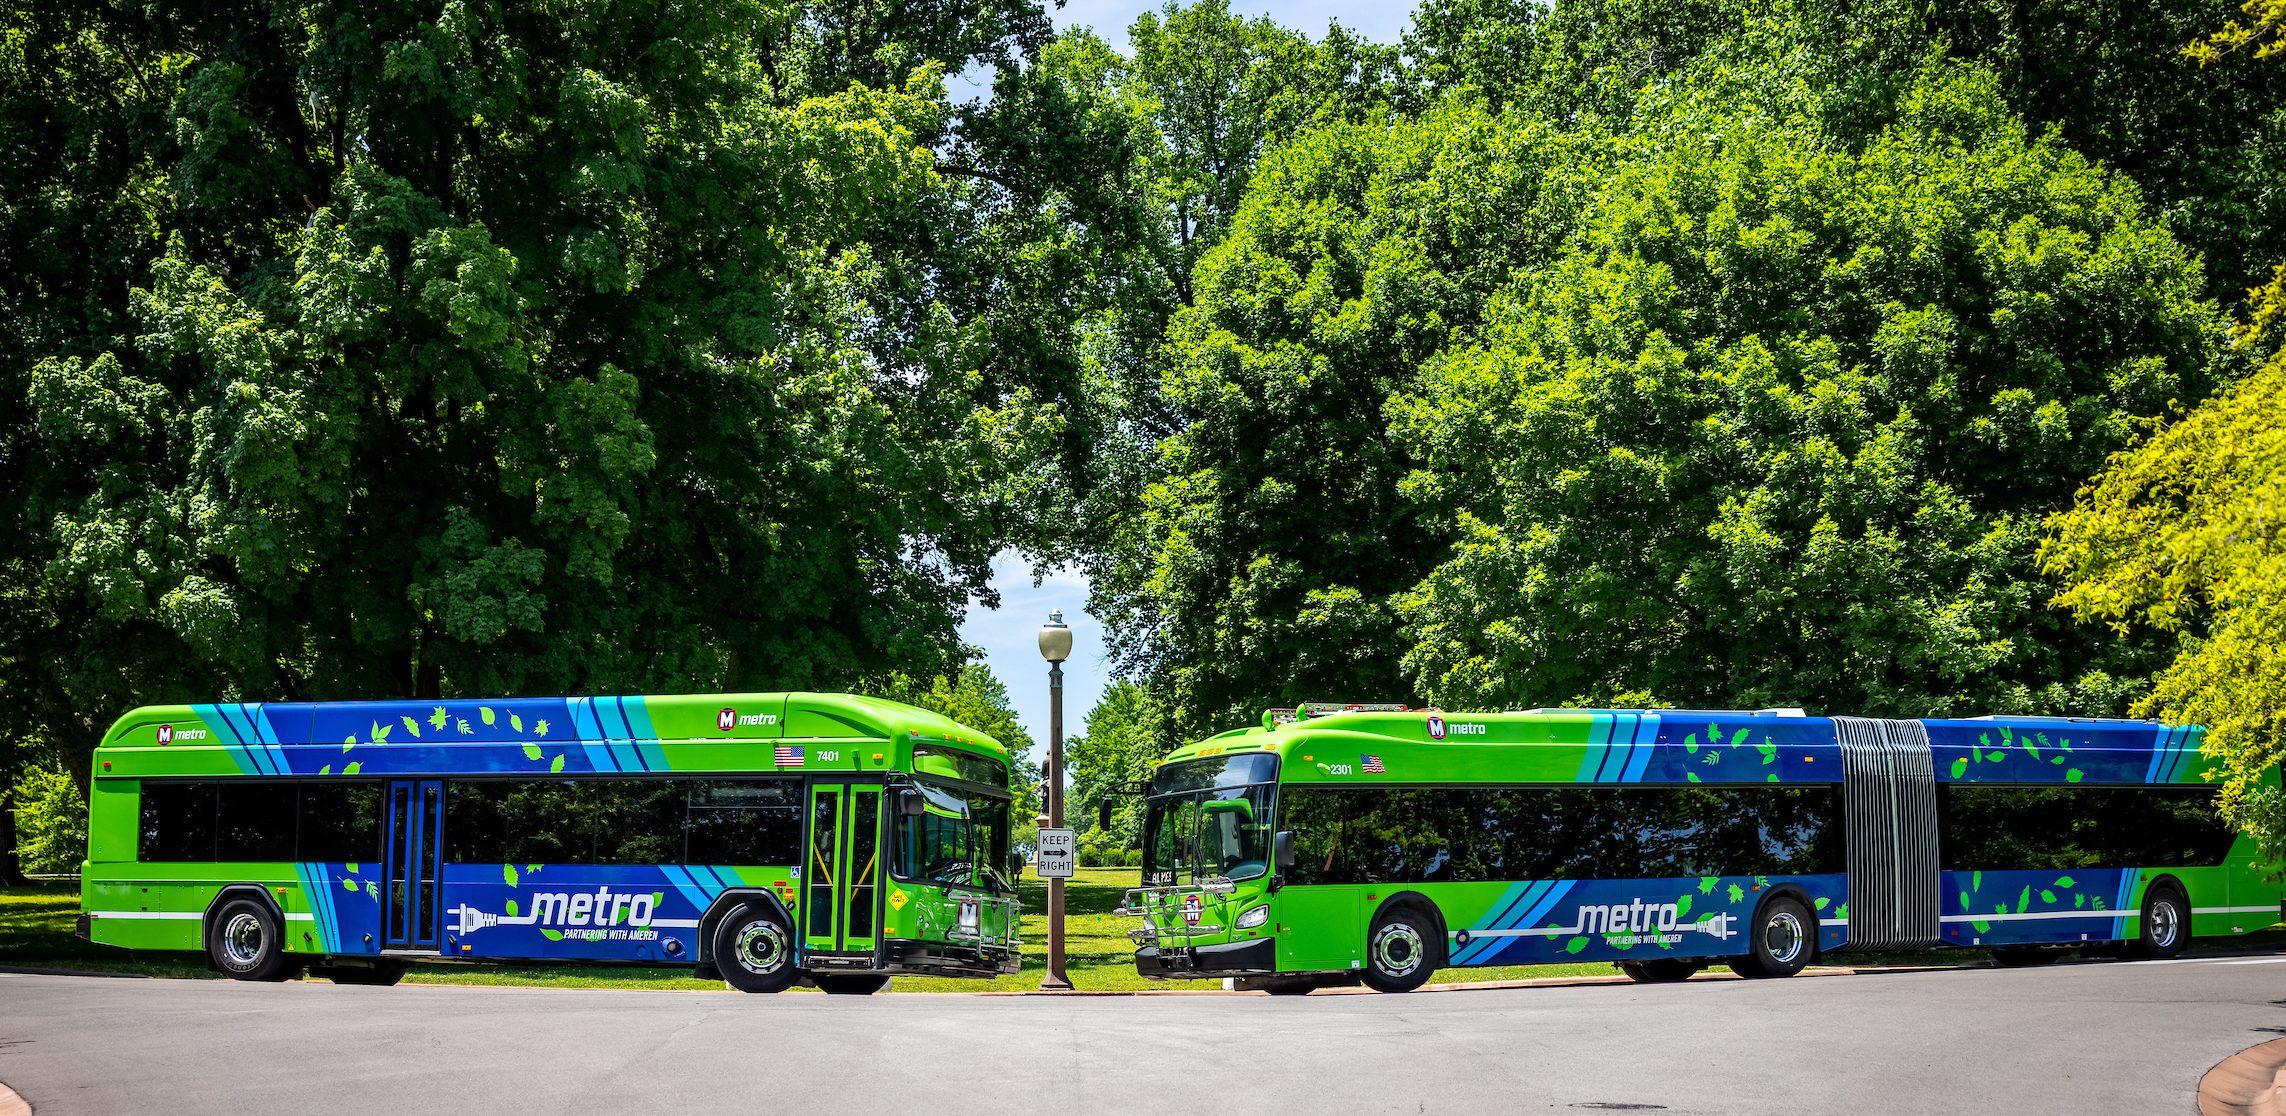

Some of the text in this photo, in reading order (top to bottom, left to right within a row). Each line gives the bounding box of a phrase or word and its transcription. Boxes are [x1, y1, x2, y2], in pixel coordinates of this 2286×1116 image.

[739, 713, 777, 726] metro
[174, 728, 206, 740] metro
[1450, 721, 1486, 735] metro
[816, 751, 839, 762] 7401
[1330, 764, 1352, 775] 2301
[1042, 835, 1070, 845] KEEP
[1040, 861, 1071, 871] RIGHT
[530, 886, 655, 926] metro
[1576, 897, 1678, 934] metro
[563, 928, 659, 941] PARTNERING WITH AMEREN
[1606, 934, 1683, 945] PARTNERING WITH AMEREN
